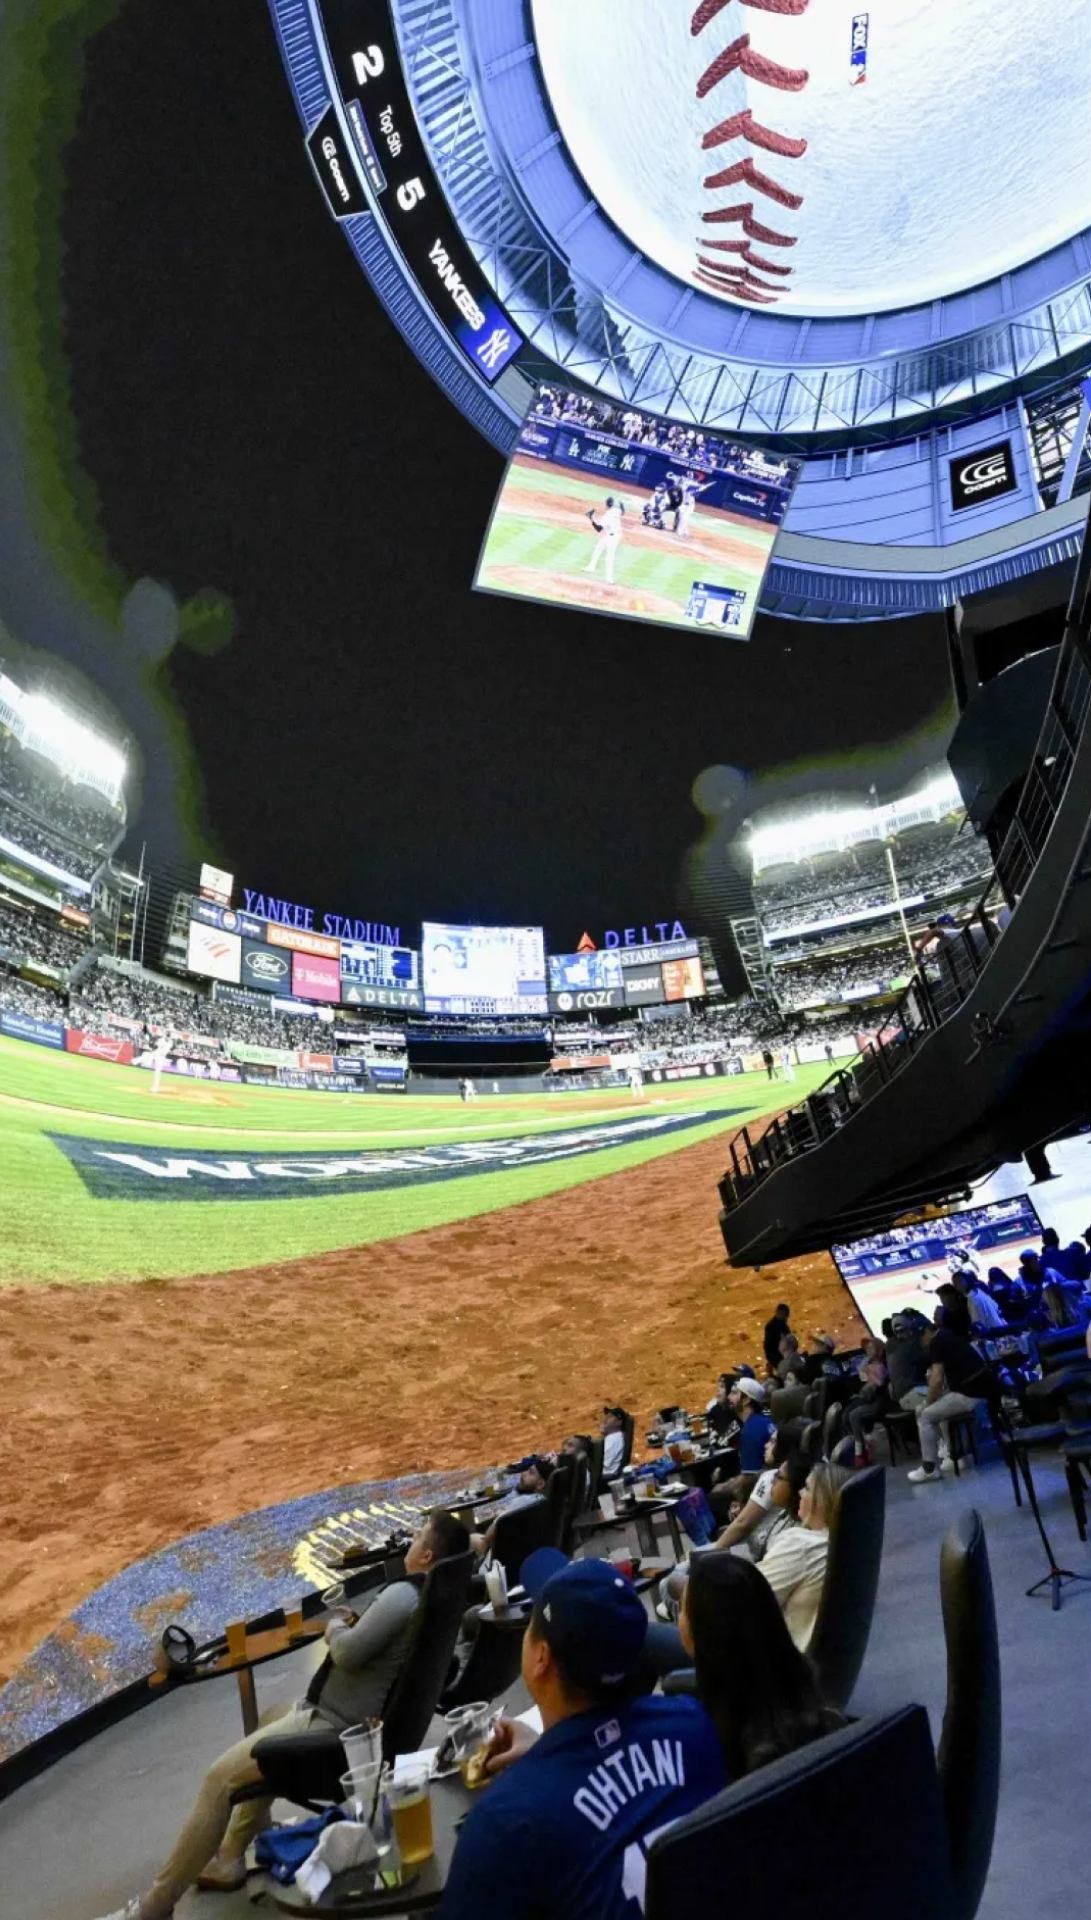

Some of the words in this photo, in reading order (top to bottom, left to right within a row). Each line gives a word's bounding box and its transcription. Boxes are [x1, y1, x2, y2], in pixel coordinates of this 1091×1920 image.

[853, 16, 867, 51] FOX
[352, 45, 384, 85] 2
[379, 104, 394, 134] Top
[386, 131, 403, 158] 5th
[396, 177, 426, 211] 5
[428, 239, 485, 331] YANKEES
[243, 888, 314, 931] YANKEE
[322, 914, 400, 948] STADIUM
[604, 919, 688, 950] DELTA
[252, 954, 281, 973] Ford
[365, 989, 419, 1006] DELTA
[576, 991, 615, 1009] razr
[625, 976, 661, 992] DKNY
[573, 1738, 686, 1832] OHTANI
